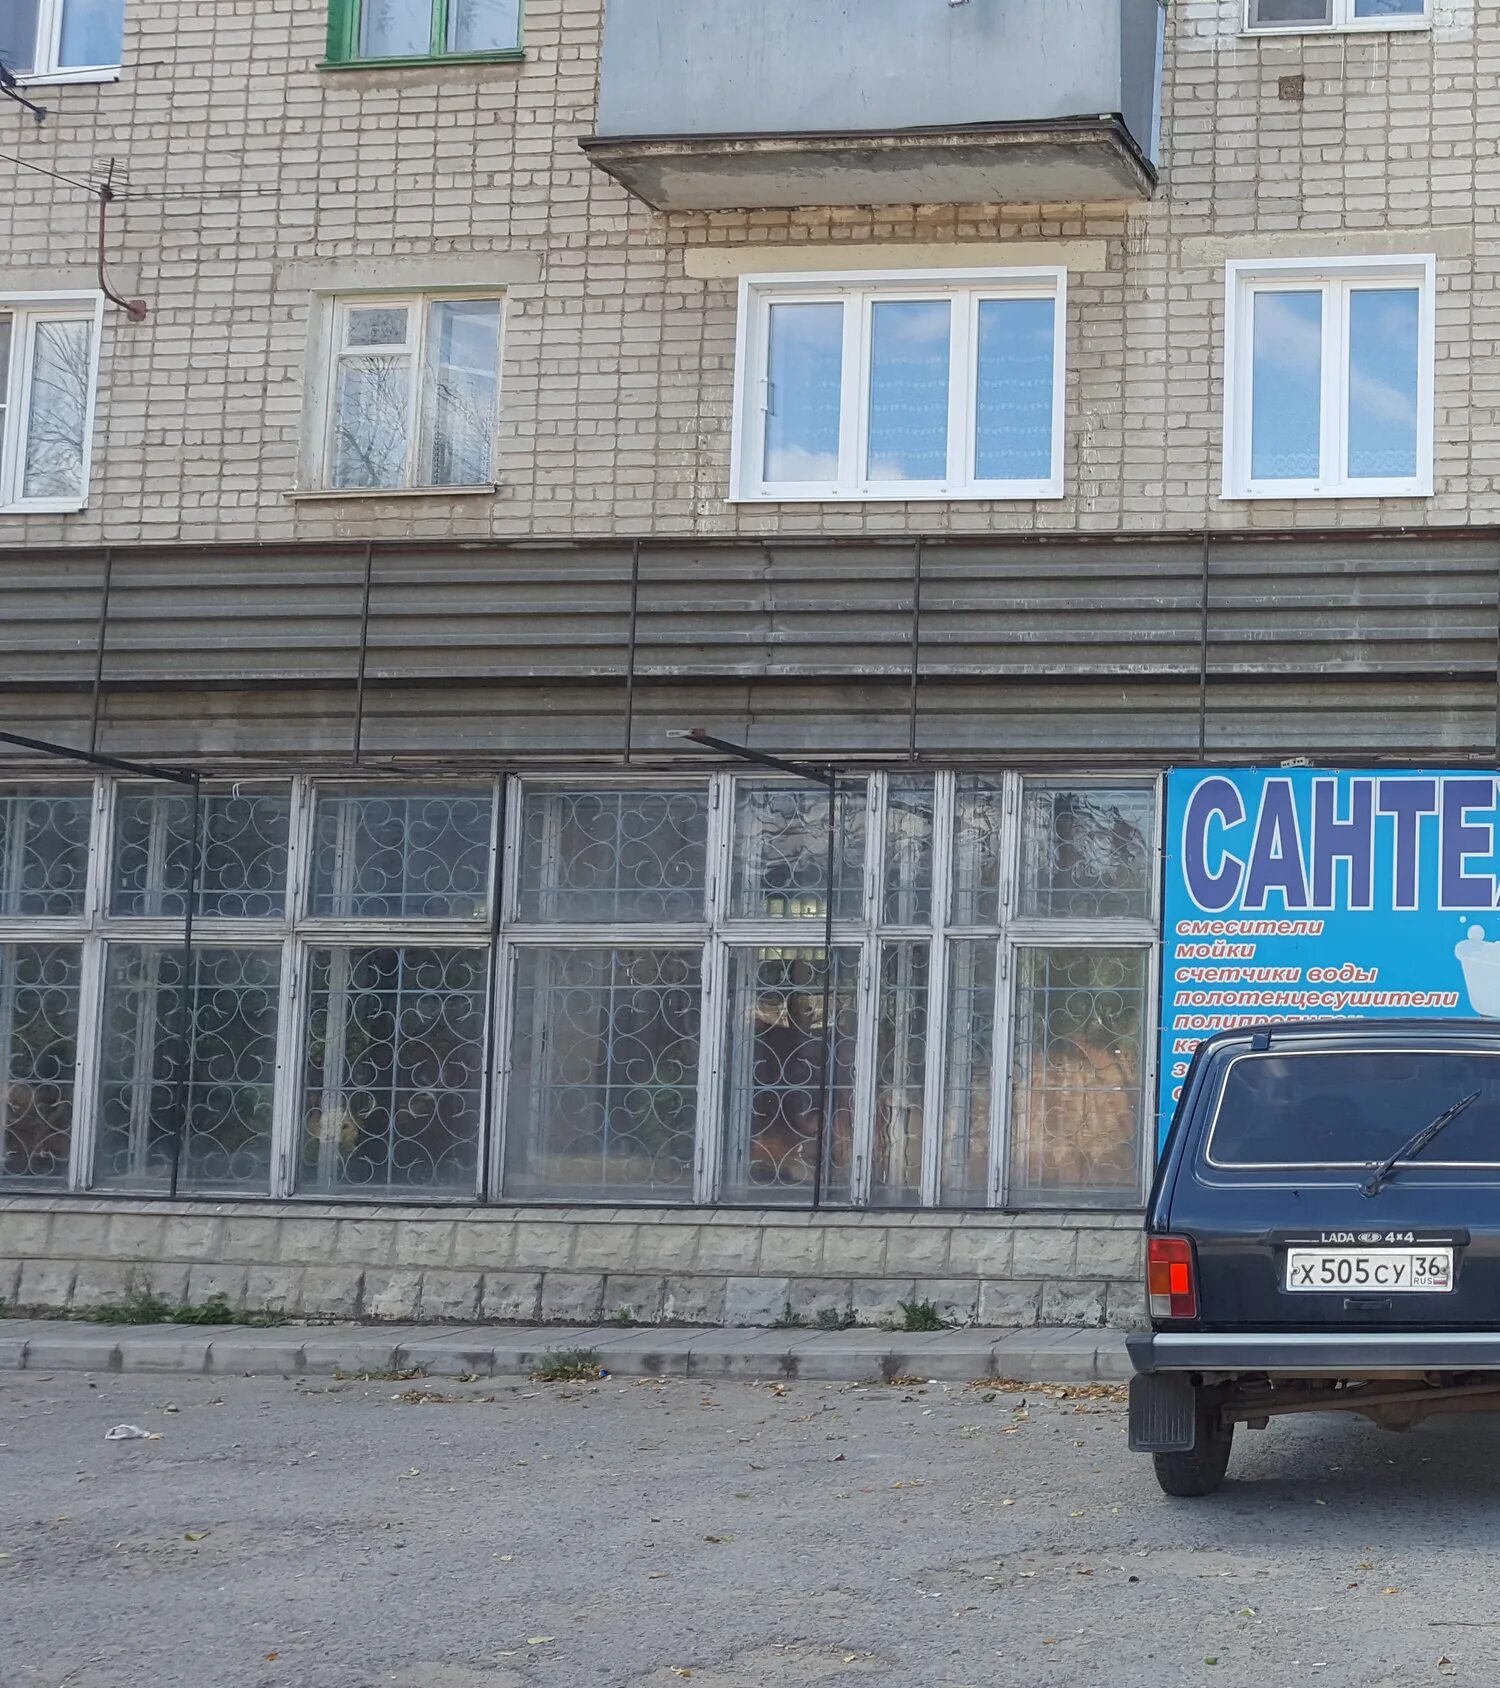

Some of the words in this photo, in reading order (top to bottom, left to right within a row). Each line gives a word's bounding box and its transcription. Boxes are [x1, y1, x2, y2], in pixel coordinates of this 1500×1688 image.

[1176, 918, 1324, 936] смесители
[1175, 940, 1256, 960] мойки
[1175, 966, 1302, 983] счетчики
[1307, 962, 1379, 984] воды
[1173, 989, 1460, 1010] полотенцесушители
[1321, 1232, 1355, 1243] LADA
[1415, 1257, 1440, 1276] 36
[1413, 1276, 1433, 1285] RUS
